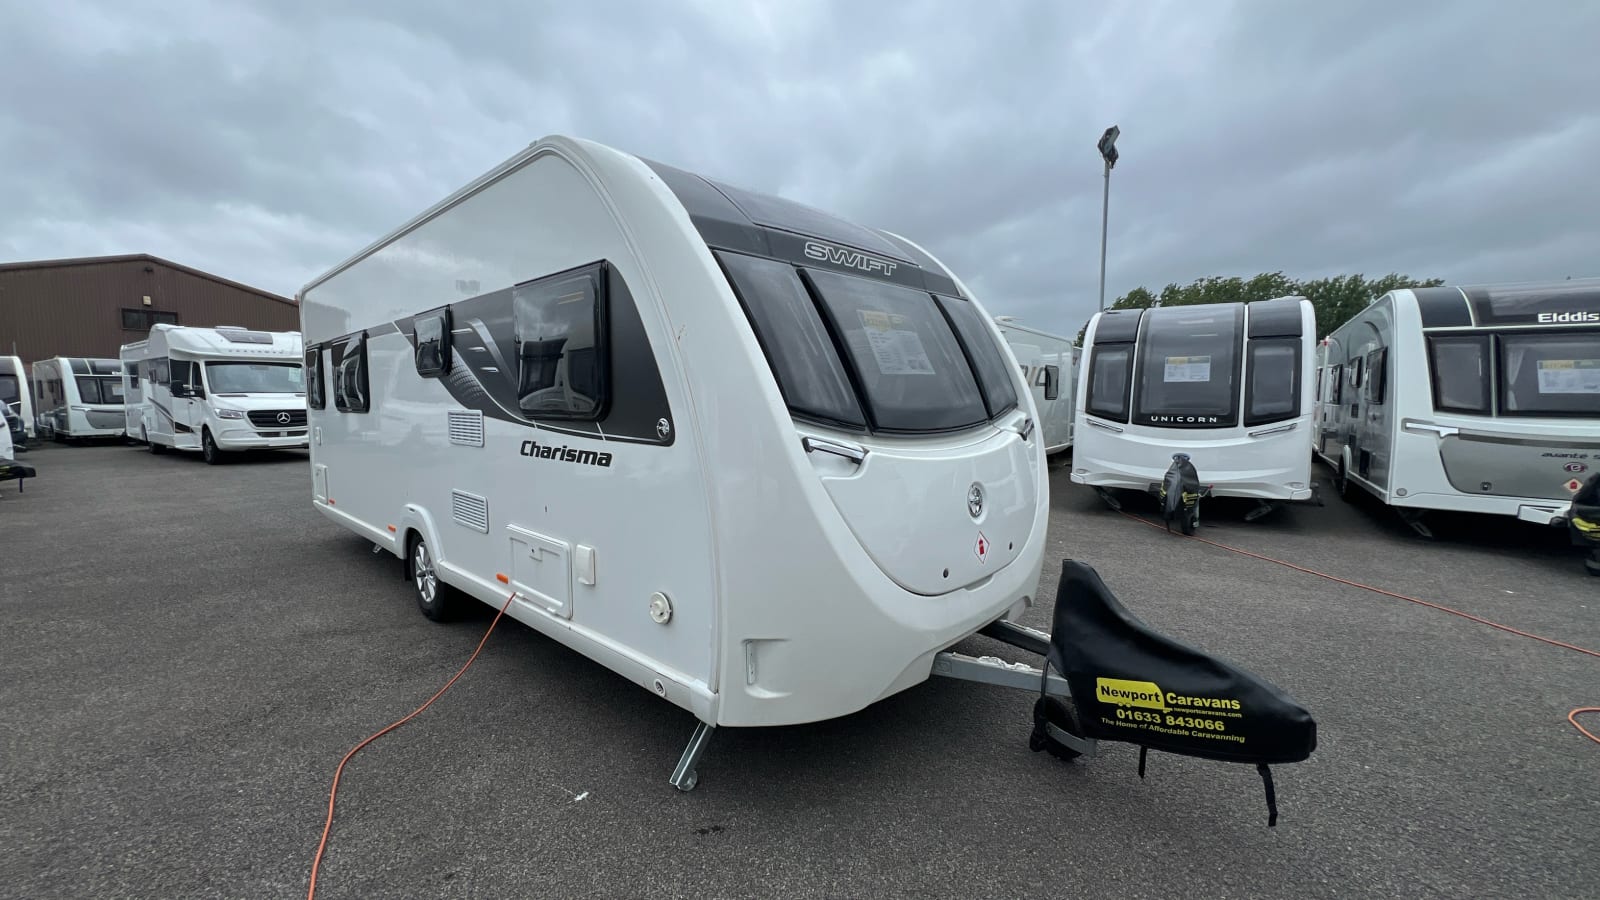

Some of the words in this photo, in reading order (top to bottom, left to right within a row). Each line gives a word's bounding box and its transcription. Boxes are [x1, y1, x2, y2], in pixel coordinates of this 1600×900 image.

[805, 241, 897, 276] SWIFT
[1538, 312, 1600, 323] Elddis
[1151, 415, 1217, 423] UNICORN
[520, 440, 613, 467] Charisma
[1100, 685, 1161, 702] Newport
[1166, 692, 1240, 709] Caravans
[1116, 709, 1162, 724] 01633
[1166, 715, 1225, 731] 843066
[1116, 721, 1138, 729] Home
[1149, 724, 1190, 735] Affordable
[1192, 731, 1245, 743] Caravanning
